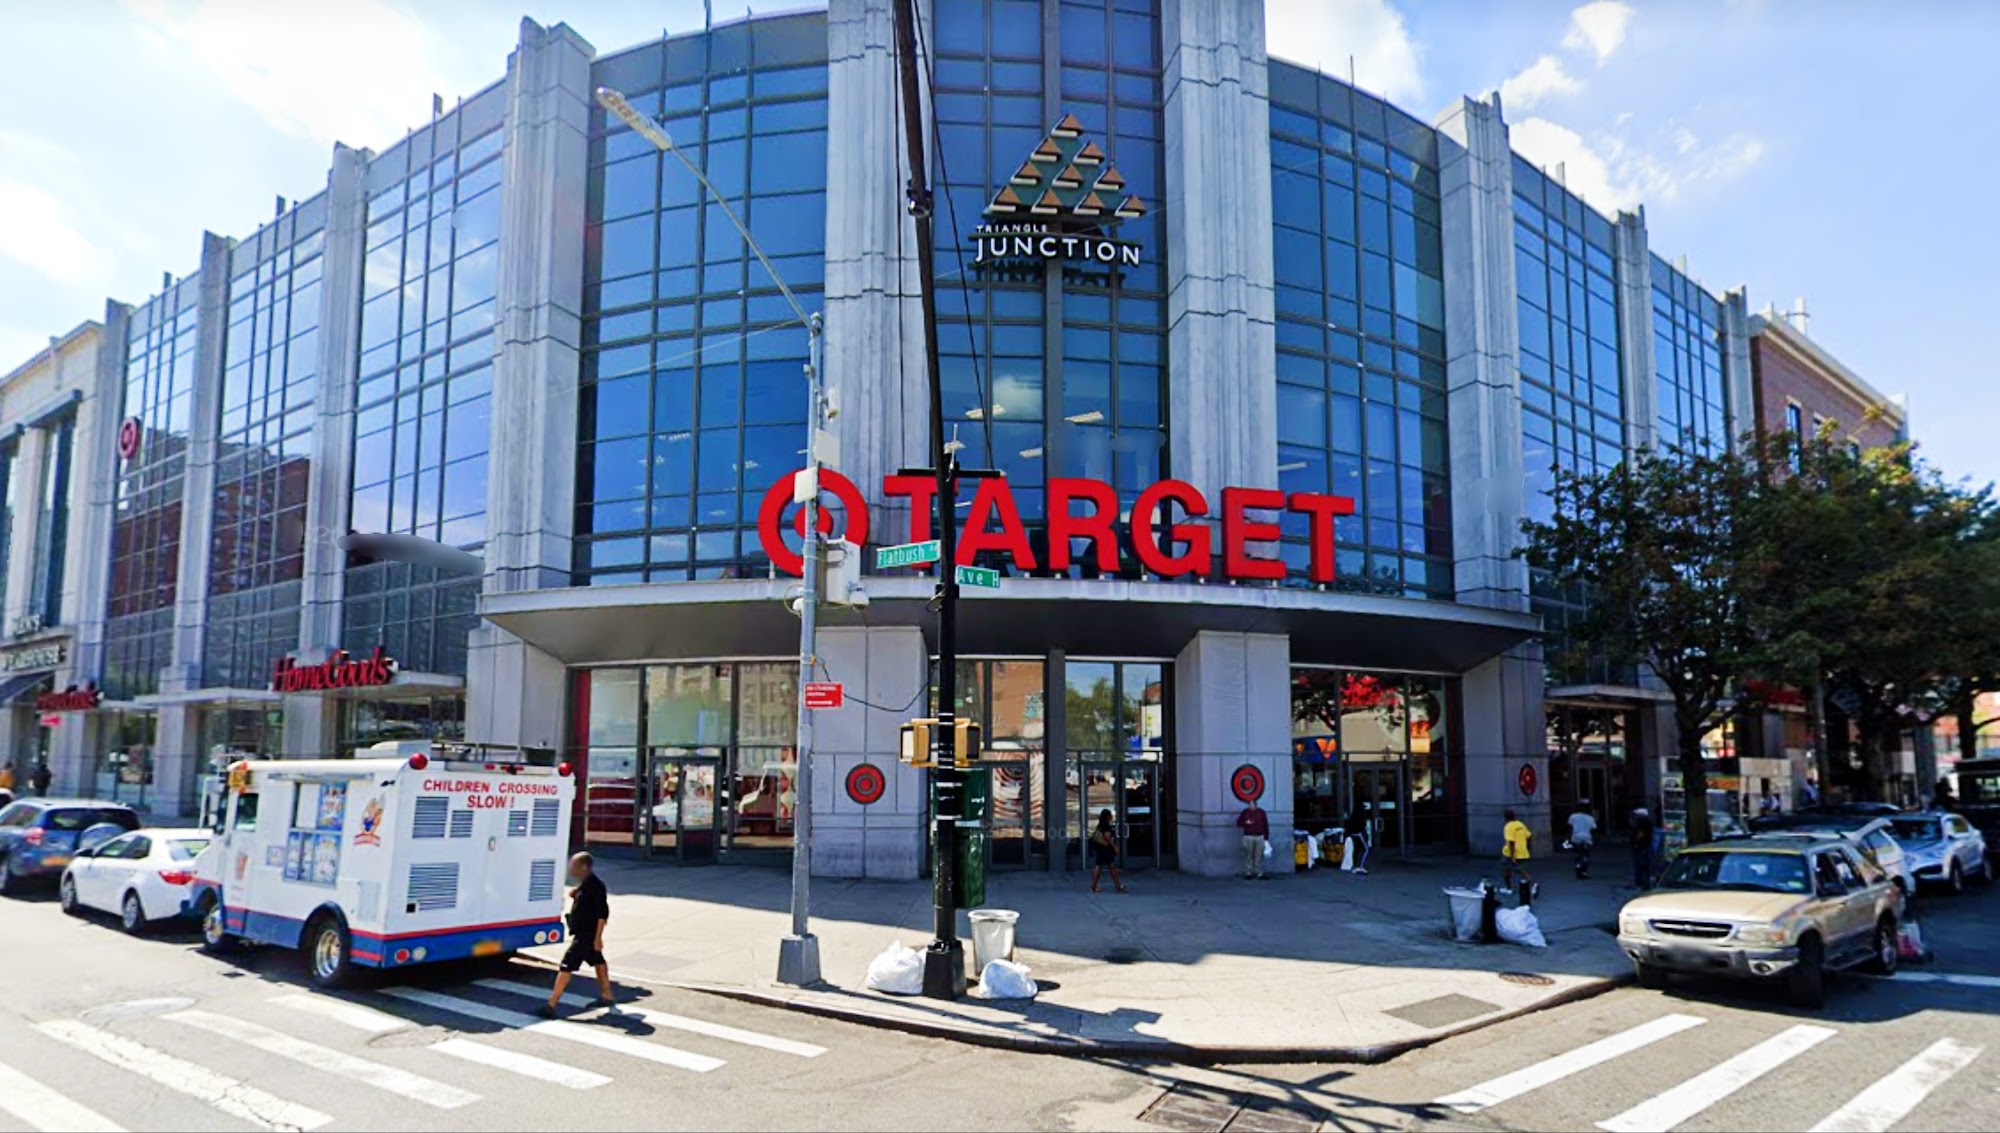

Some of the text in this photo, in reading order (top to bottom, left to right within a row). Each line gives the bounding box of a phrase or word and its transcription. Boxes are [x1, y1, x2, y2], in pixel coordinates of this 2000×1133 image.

[975, 224, 1047, 233] TRIANGLE
[975, 237, 1139, 265] JUNCTION
[883, 475, 1354, 583] TARGET
[878, 546, 924, 567] Flatbush
[958, 569, 999, 588] Ave H
[272, 646, 387, 691] HomeGoods
[423, 778, 558, 795] CHILDREN CROSSING
